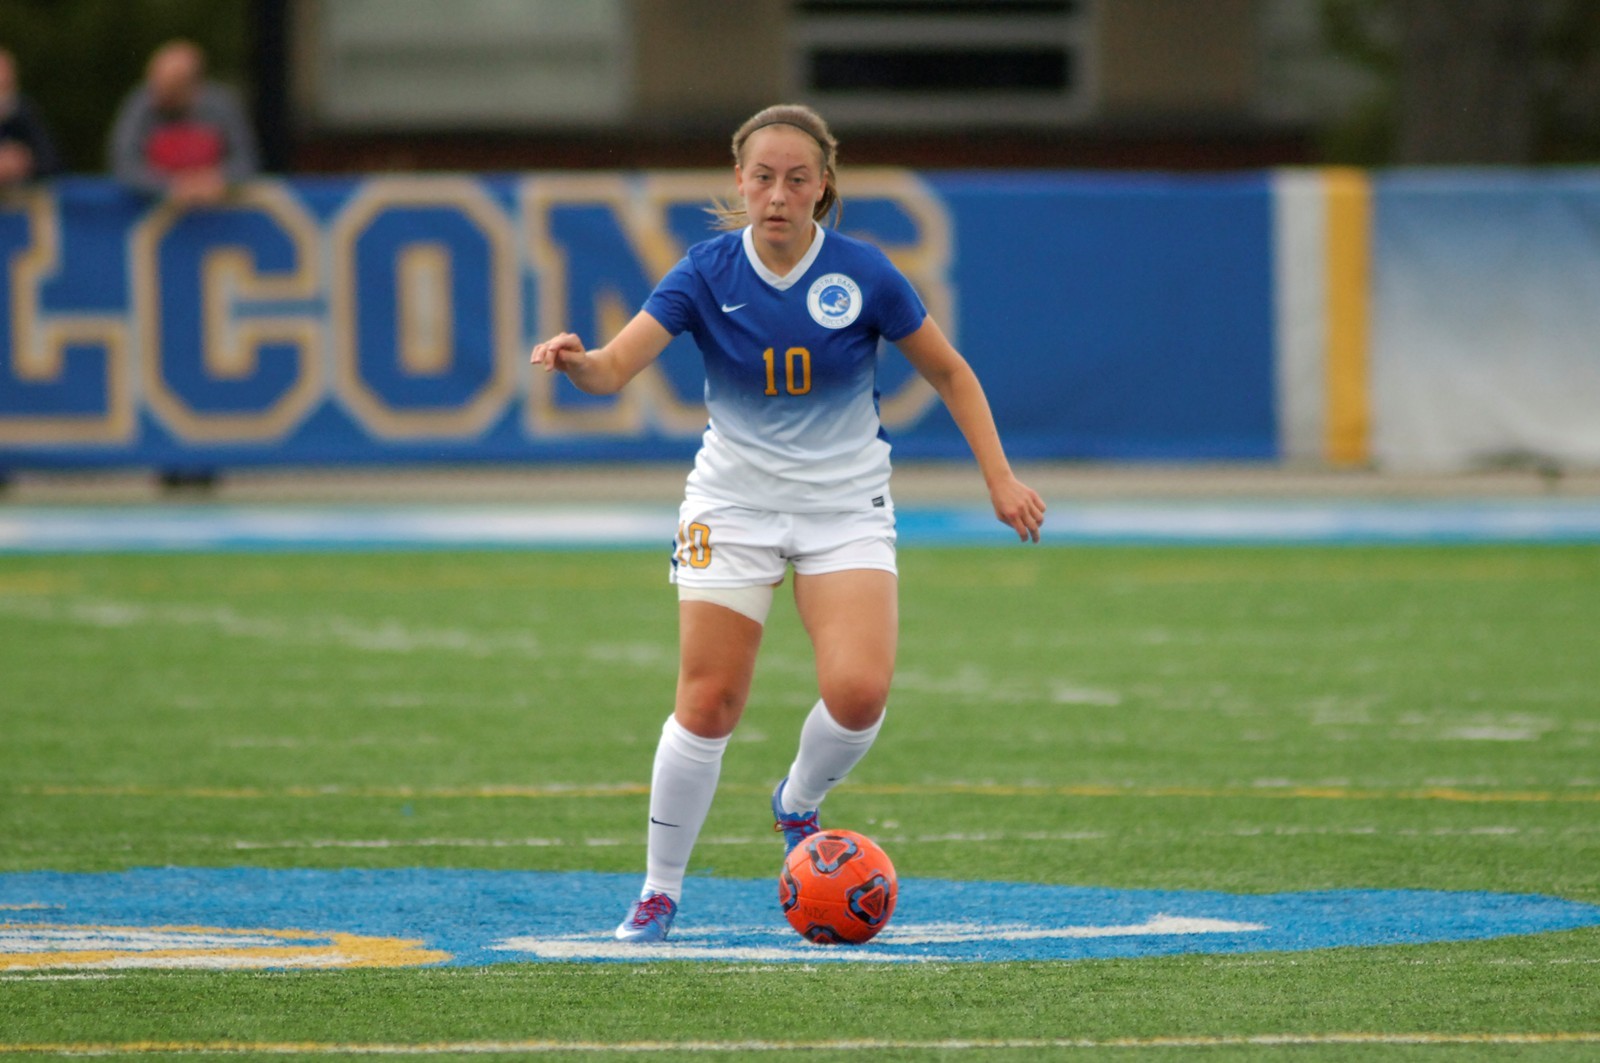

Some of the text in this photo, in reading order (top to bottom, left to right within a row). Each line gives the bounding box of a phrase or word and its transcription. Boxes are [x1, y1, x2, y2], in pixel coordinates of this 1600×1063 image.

[812, 277, 857, 295] NOTRE DAME
[821, 315, 851, 326] SOCCER
[763, 347, 811, 396] 10
[677, 520, 712, 569] 10
